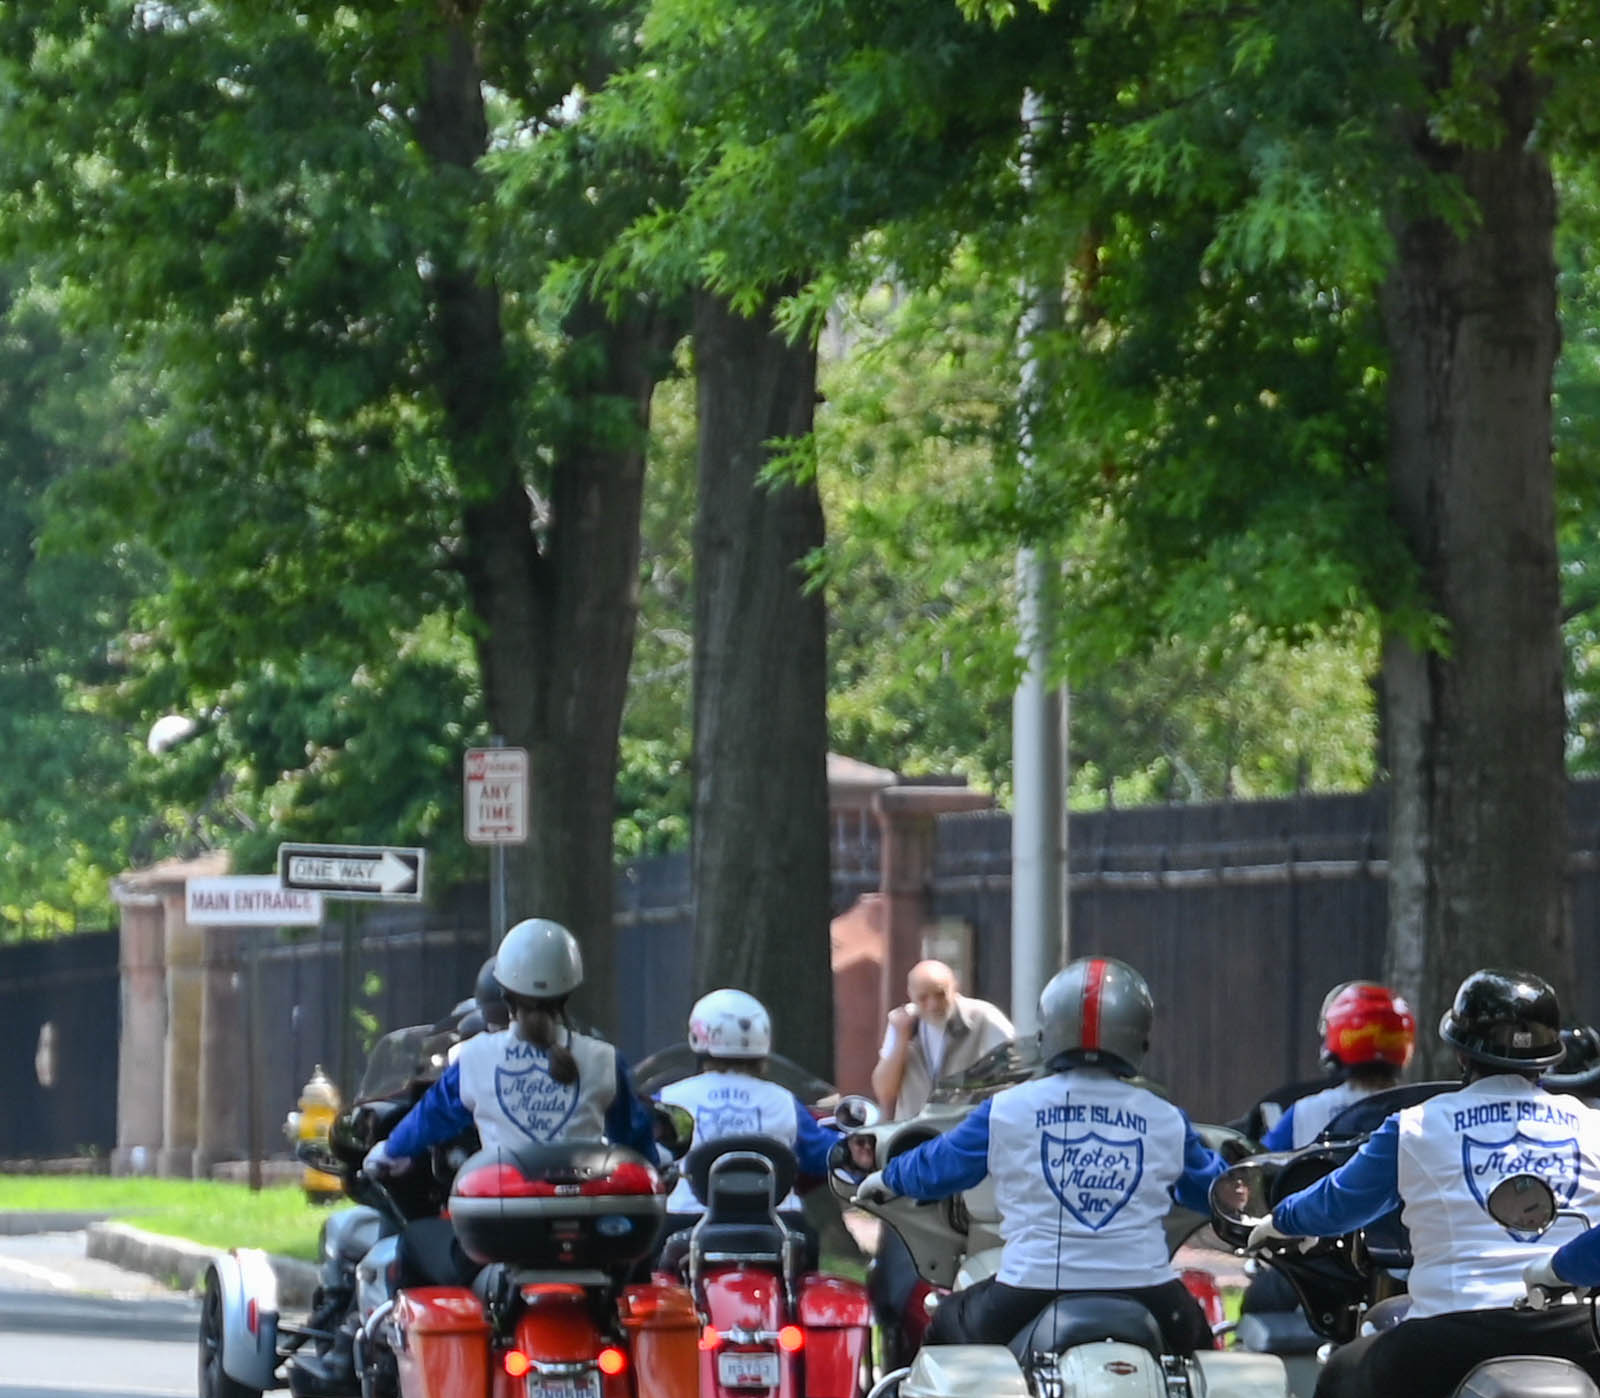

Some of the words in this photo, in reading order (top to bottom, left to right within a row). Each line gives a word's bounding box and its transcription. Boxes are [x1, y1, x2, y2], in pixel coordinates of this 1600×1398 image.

[480, 783, 511, 799] ANY
[479, 803, 513, 819] TIME
[294, 861, 330, 878] ONE
[339, 862, 376, 880] WAY
[191, 892, 231, 911] MAIN
[234, 891, 313, 911] ENTRANCE
[504, 1076, 569, 1094] Motor
[511, 1094, 566, 1112] Maids
[708, 1087, 750, 1104] OHIO
[527, 1115, 552, 1131] Inc
[1035, 1104, 1087, 1129] RHODE
[1090, 1105, 1147, 1135] ISLAND
[1453, 1101, 1512, 1132] RHODE
[1051, 1146, 1131, 1170] Motor
[1474, 1150, 1567, 1176] Motor
[1060, 1168, 1126, 1191] Maids
[1078, 1191, 1110, 1212] Inc
